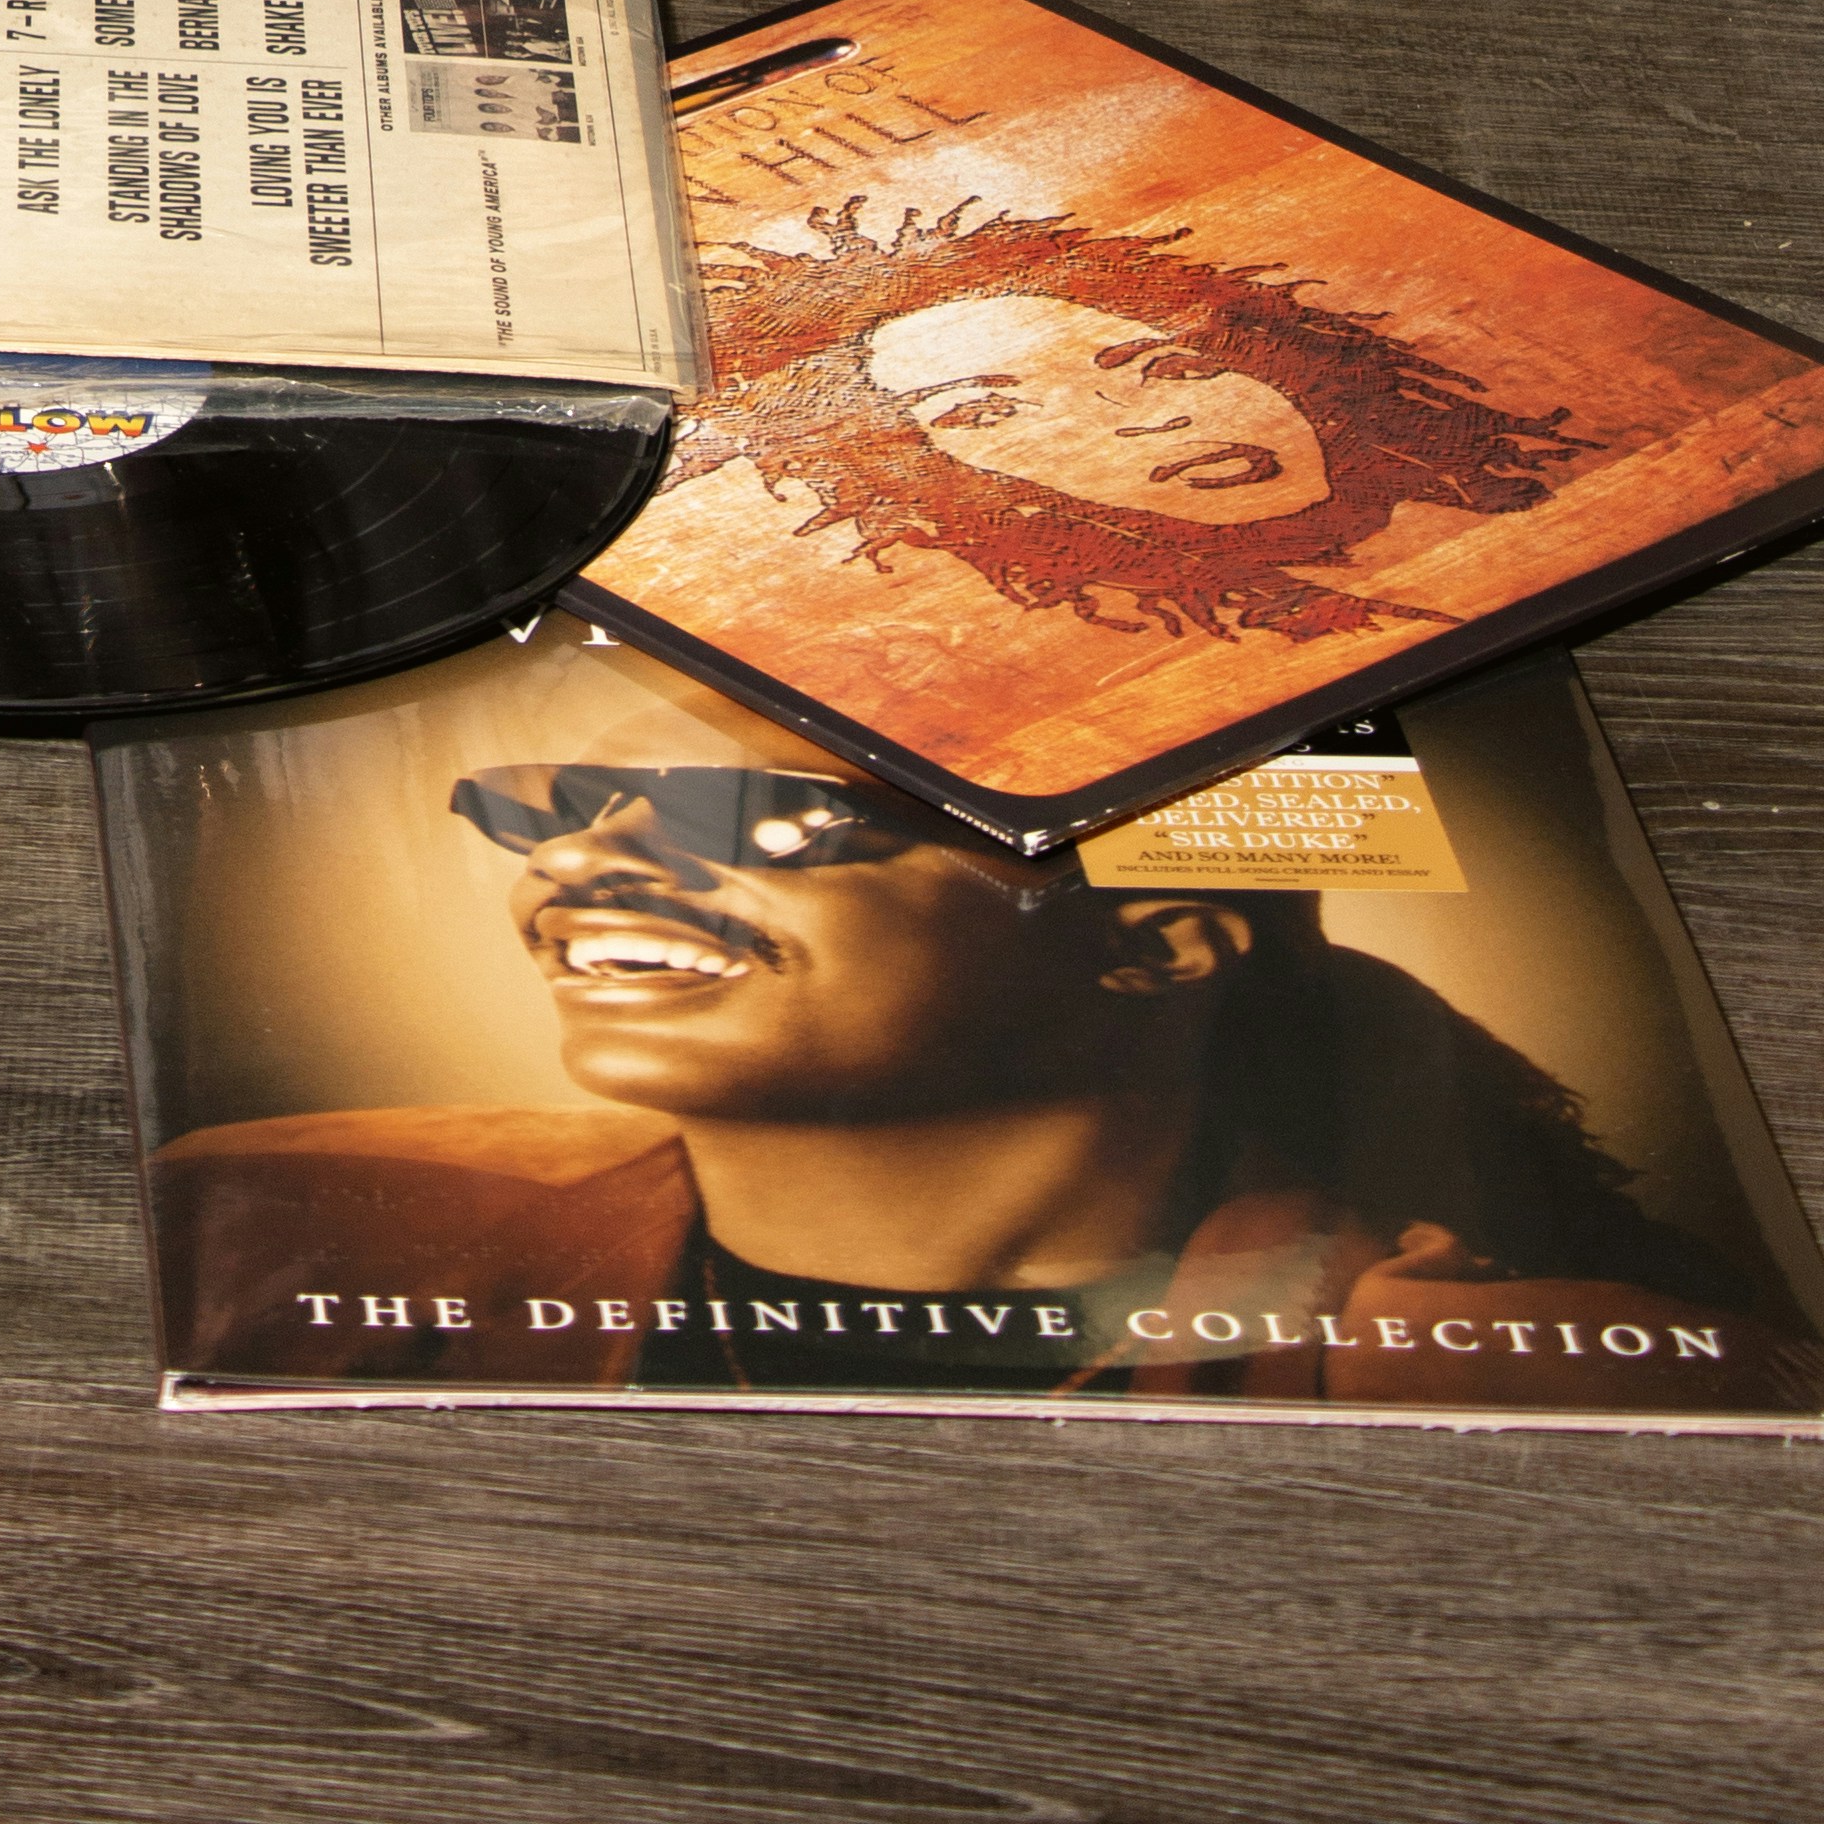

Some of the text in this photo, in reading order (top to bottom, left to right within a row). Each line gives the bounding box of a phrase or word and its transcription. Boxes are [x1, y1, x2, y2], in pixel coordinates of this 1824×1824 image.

[264, 0, 306, 55] SHAKE
[375, 52, 391, 94] ALBUMS
[378, 98, 393, 131] OTHER
[421, 88, 433, 105] TOPS
[17, 64, 60, 214] ASK THE LONELY
[108, 70, 150, 223] STANDING IN THE
[158, 73, 201, 240] SHADOWS OF LOVE
[246, 77, 293, 207] LOVING YOU IS
[741, 94, 992, 185] HILL
[302, 80, 352, 266] SWEETER THAN EVER
[487, 215, 505, 254] YOUNG
[491, 258, 506, 272] OF
[492, 277, 511, 316] SOUND
[1256, 793, 1421, 813] SEALED,
[1117, 865, 1431, 877] INCLUDES FULL SONG CREDITS AND ESSAY
[1138, 852, 1401, 865] AND SO MANY MORE!
[296, 1293, 1725, 1359] THE DEFINITIVE COLLECTION
